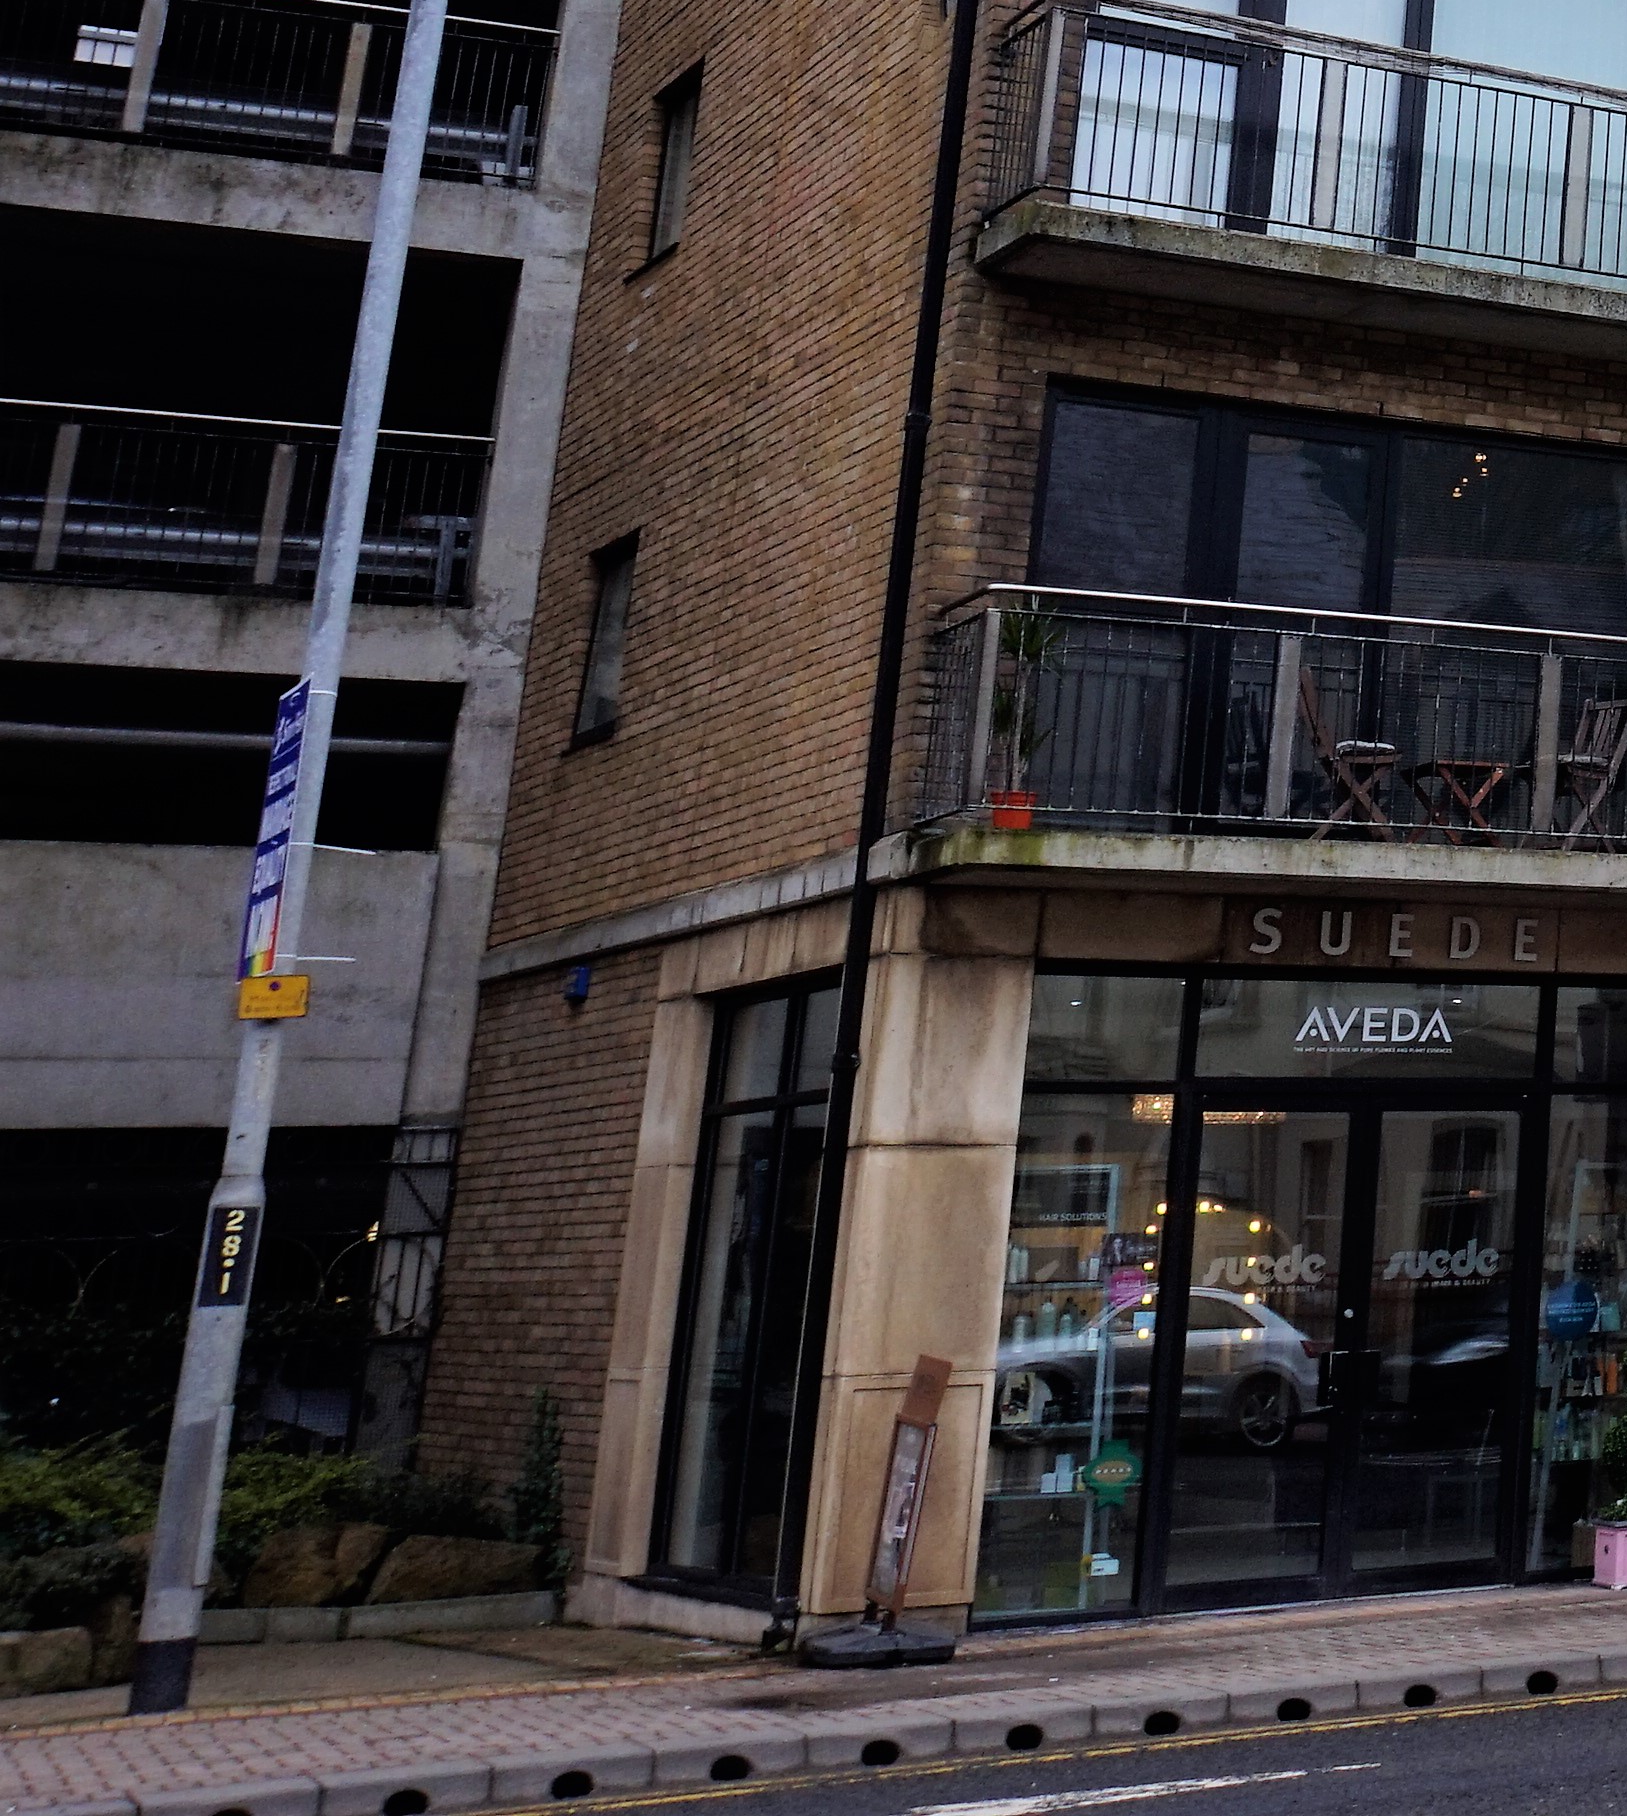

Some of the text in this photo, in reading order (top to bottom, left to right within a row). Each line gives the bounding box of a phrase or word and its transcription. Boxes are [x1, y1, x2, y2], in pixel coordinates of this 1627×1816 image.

[1249, 907, 1539, 962] SUEDE
[1295, 1006, 1453, 1043] AVEDA
[1382, 1238, 1500, 1281] suede
